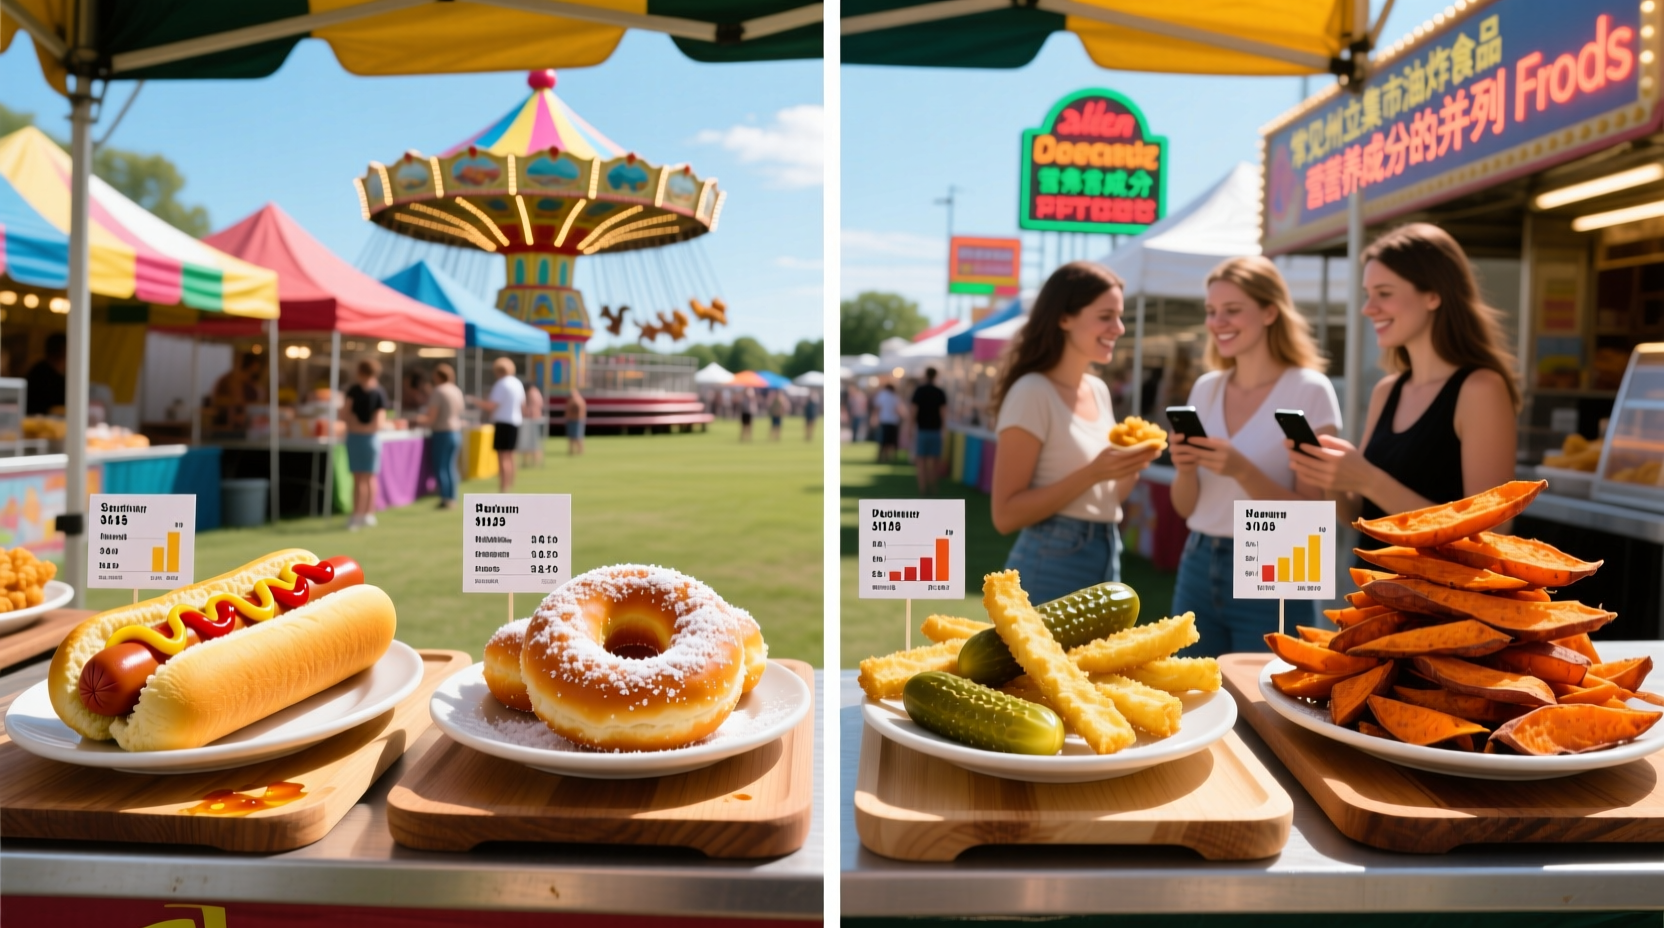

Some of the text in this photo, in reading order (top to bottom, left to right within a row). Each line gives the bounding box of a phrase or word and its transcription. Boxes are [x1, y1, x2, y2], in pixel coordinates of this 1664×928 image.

[1290, 14, 1502, 169] 常见州立集市油炸食品
[1514, 13, 1634, 123] Frods
